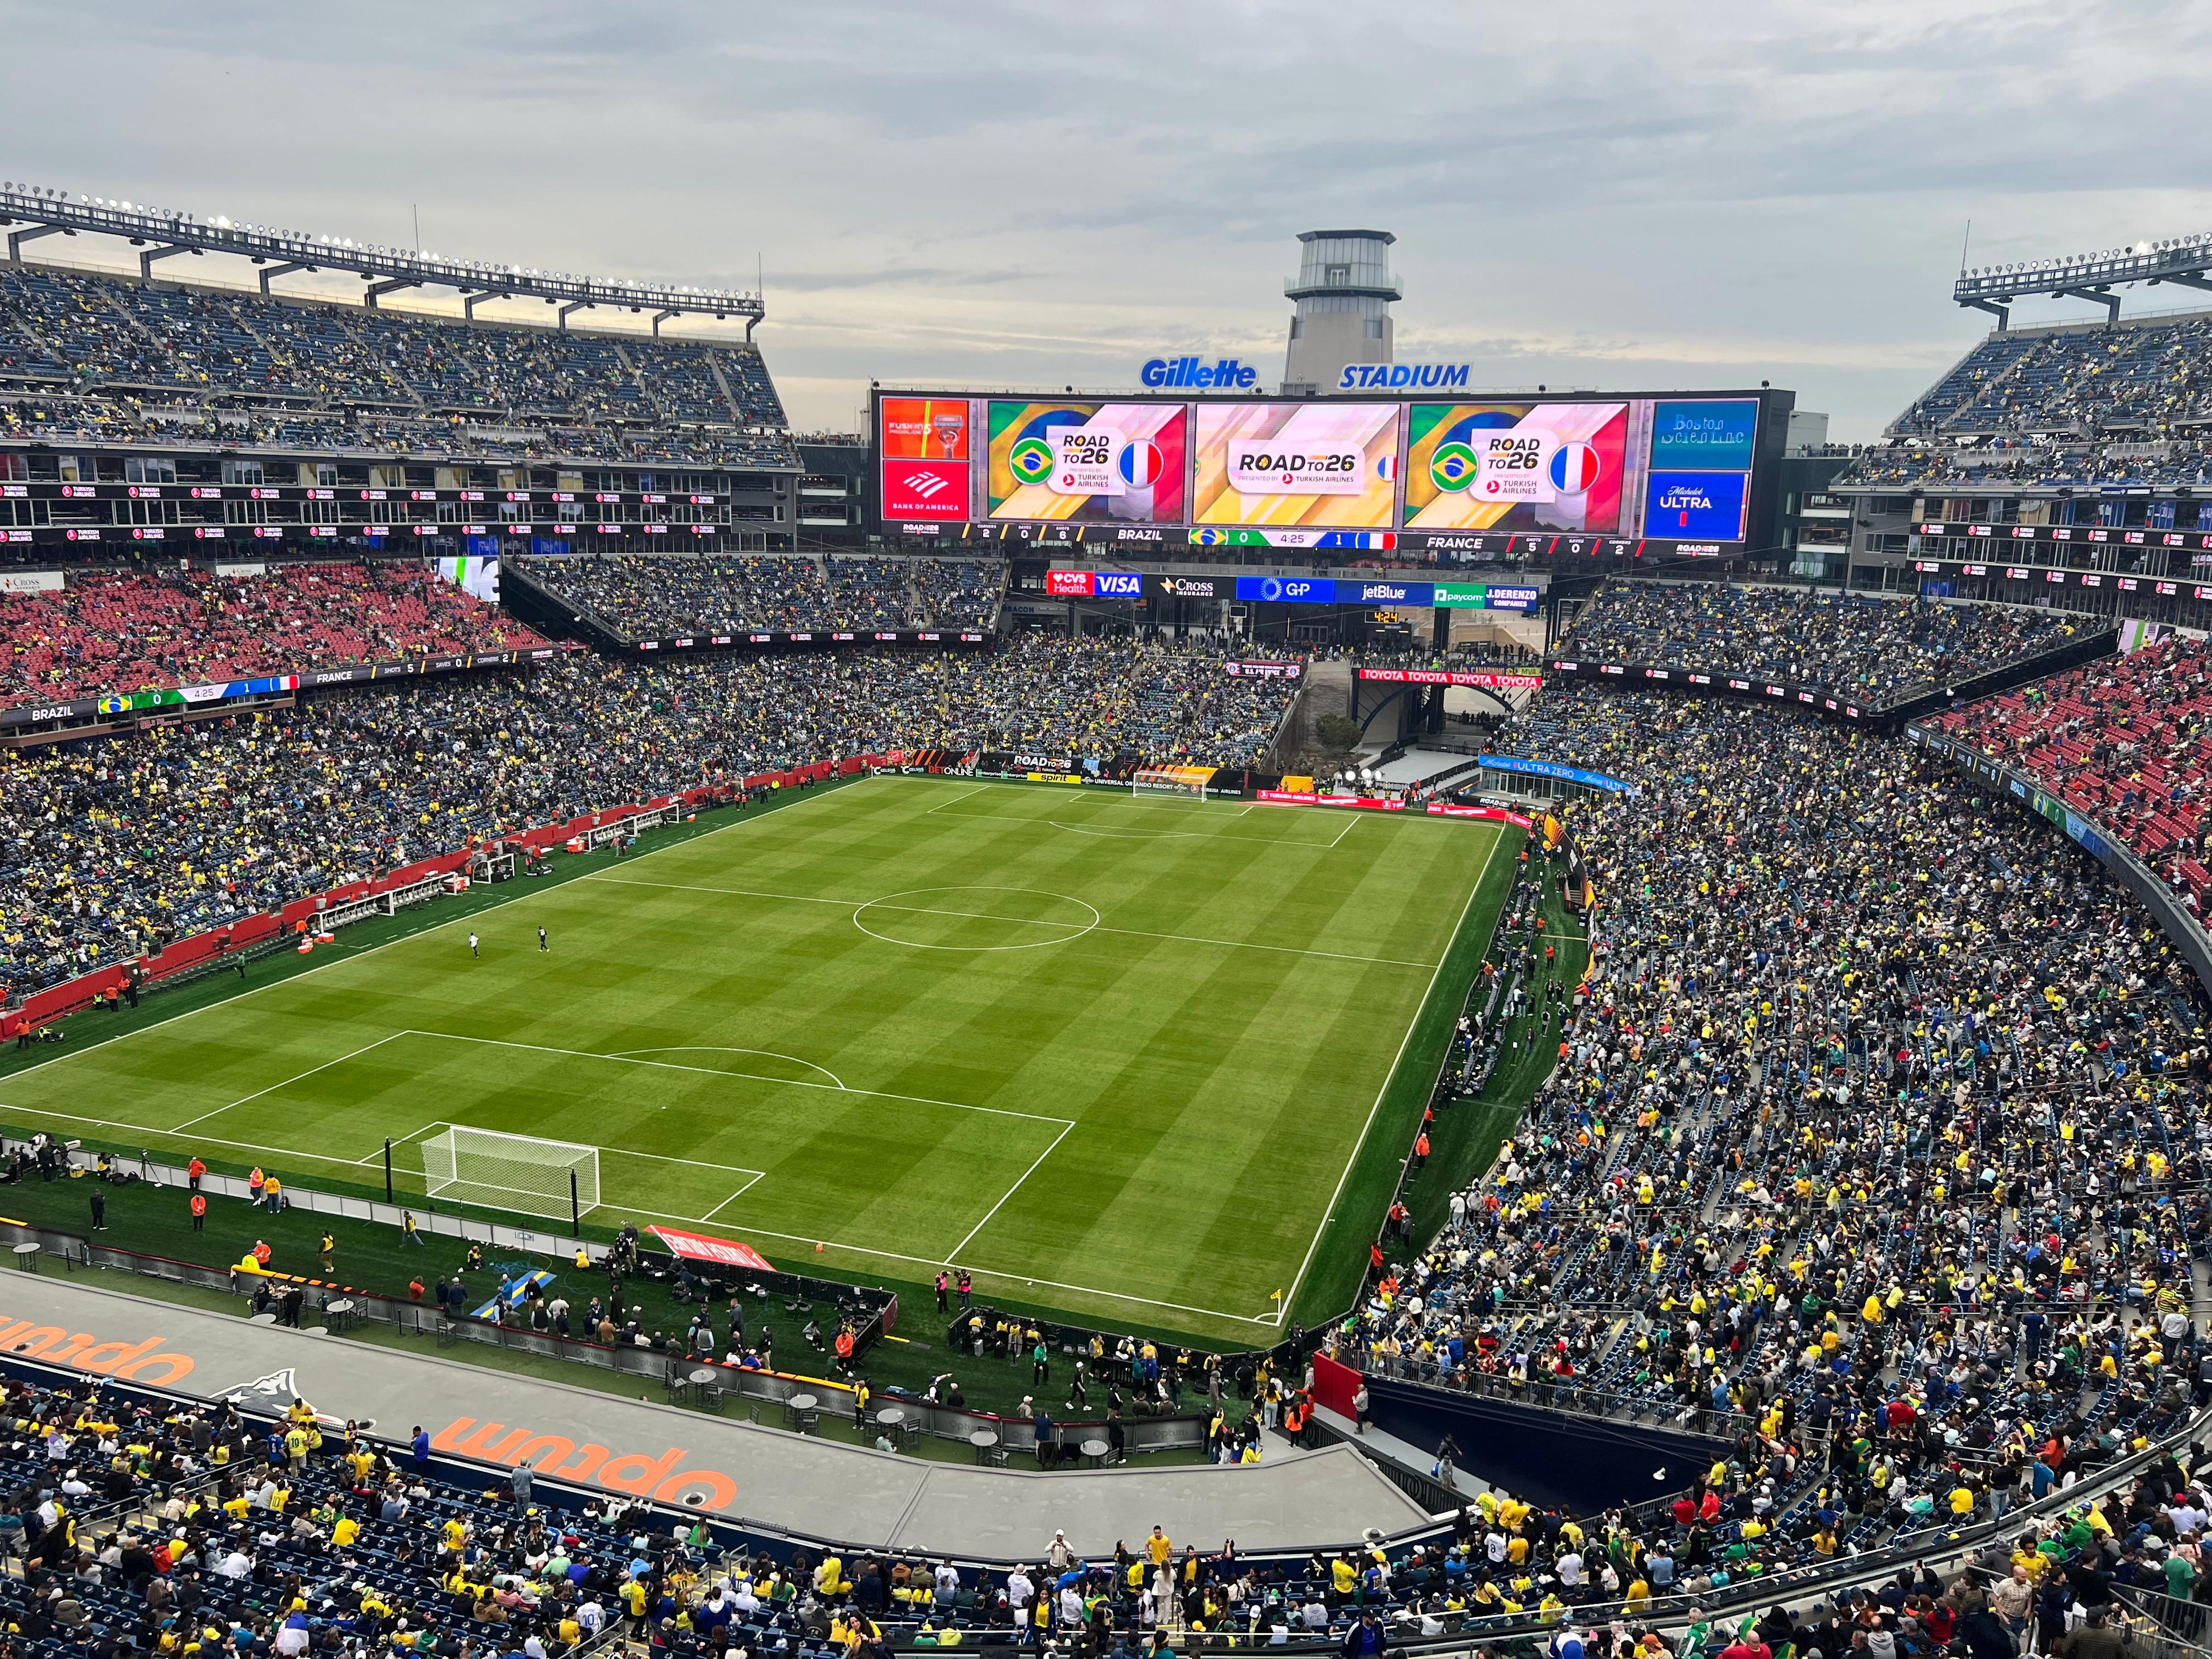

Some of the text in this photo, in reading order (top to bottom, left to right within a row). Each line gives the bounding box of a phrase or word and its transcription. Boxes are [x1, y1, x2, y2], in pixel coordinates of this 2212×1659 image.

[1141, 358, 1470, 388] Gillette STADIUM
[1063, 435, 1109, 447] ROAD
[1489, 438, 1540, 451] ROAD
[1063, 455, 1080, 464] TO
[1239, 454, 1305, 471] ROAD
[1307, 462, 1324, 471] TO
[1488, 459, 1506, 469] TO
[1660, 496, 1711, 509] ULTRA
[983, 529, 990, 538] 2
[1021, 529, 1028, 539] 0
[1059, 531, 1067, 539] 6
[1119, 529, 1163, 541] BRAZIL
[1240, 532, 1247, 542] 0
[1281, 534, 1304, 544] 4:25
[1336, 534, 1342, 545] 1
[1427, 537, 1483, 548] FRANCE
[1529, 542, 1536, 552] 5
[1572, 543, 1580, 553] 0
[1615, 545, 1623, 554] 2
[1063, 574, 1086, 583] CVS
[1054, 583, 1087, 594] Health
[1096, 576, 1140, 593] VISA
[1175, 578, 1213, 591] CROSS
[1362, 584, 1405, 600] jetBlue
[1447, 593, 1482, 602] paycom
[1494, 599, 1527, 607] COMPANIES
[1374, 612, 1399, 623] 4:24
[408, 664, 414, 673] 5
[455, 659, 462, 668] 0
[502, 654, 509, 663] 2
[1471, 666, 1505, 675] CANARINHO
[317, 671, 352, 683] FRANCE
[1365, 670, 1538, 686] TOYOTA TOYOTA TOYOTA TOYOTA
[32, 706, 74, 721] BRAZIL
[152, 694, 162, 705] 0
[244, 683, 249, 693] 1
[1944, 744, 1949, 755] 2
[1014, 755, 1048, 766] ROAD
[1517, 762, 1550, 774] ULTRA
[1551, 766, 1574, 778] ZERO
[1991, 769, 1996, 781] 6
[2010, 779, 2025, 798] BRAZIL
[1480, 798, 1500, 806] ROAD
[462, 1324, 489, 1337] Optum
[518, 1337, 546, 1348] Optum
[575, 1348, 604, 1361] Optum
[633, 1357, 663, 1369] Optum
[821, 1395, 851, 1405] Optum
[1153, 1429, 1188, 1439] Optum
[291, 1437, 300, 1448] 10
[432, 1416, 738, 1511] Optum
[583, 1613, 594, 1626] 10
